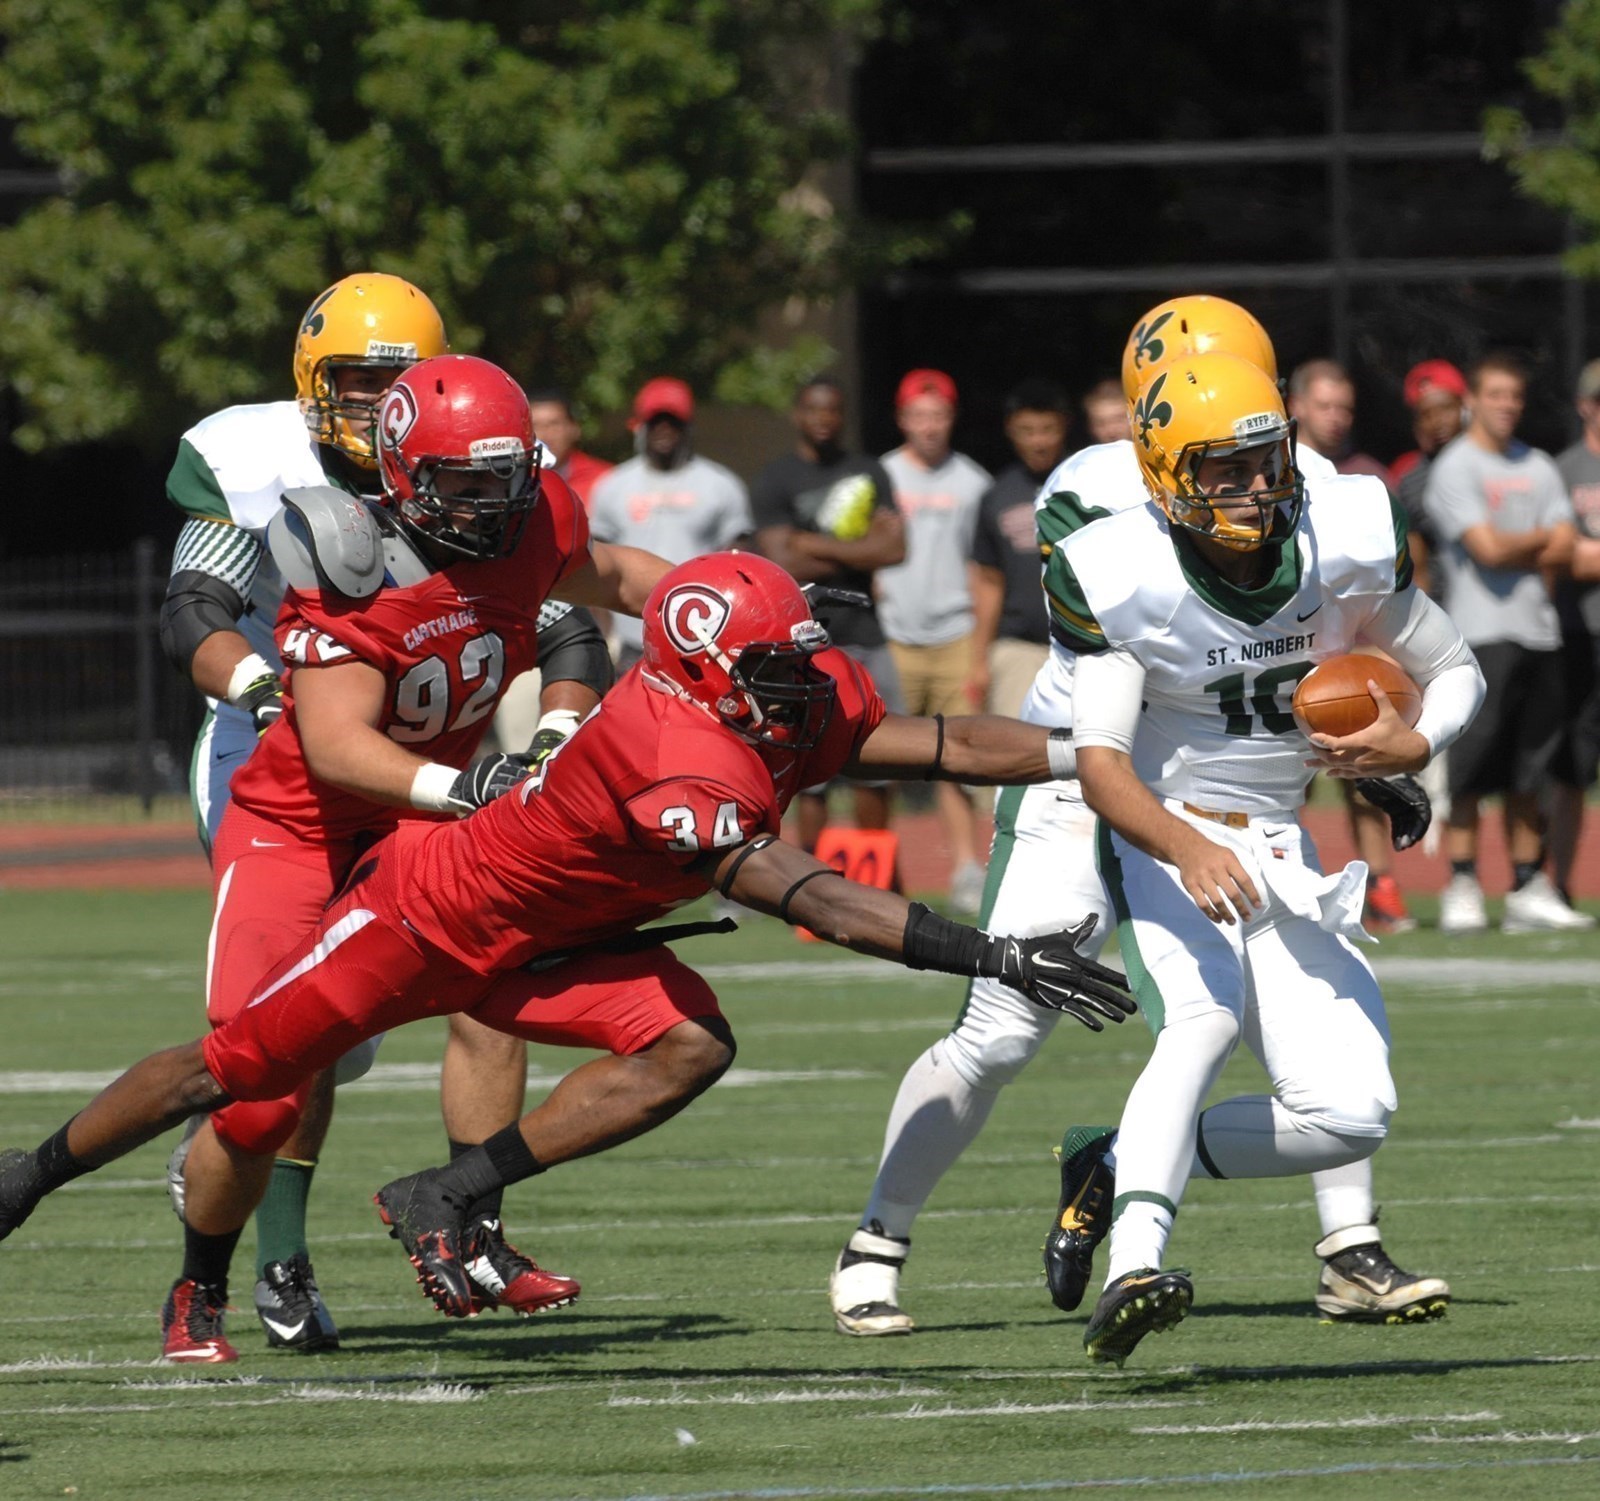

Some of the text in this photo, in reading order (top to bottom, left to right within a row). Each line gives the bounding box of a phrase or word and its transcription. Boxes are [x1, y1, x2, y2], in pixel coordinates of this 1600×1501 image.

[1246, 414, 1270, 431] RYFP
[482, 438, 511, 452] Riddell
[402, 608, 478, 652] CARTHAGE
[1207, 632, 1316, 667] ST. NORBERT
[387, 631, 506, 744] 92
[660, 801, 744, 852] 34
[464, 1254, 507, 1297] NIKE
